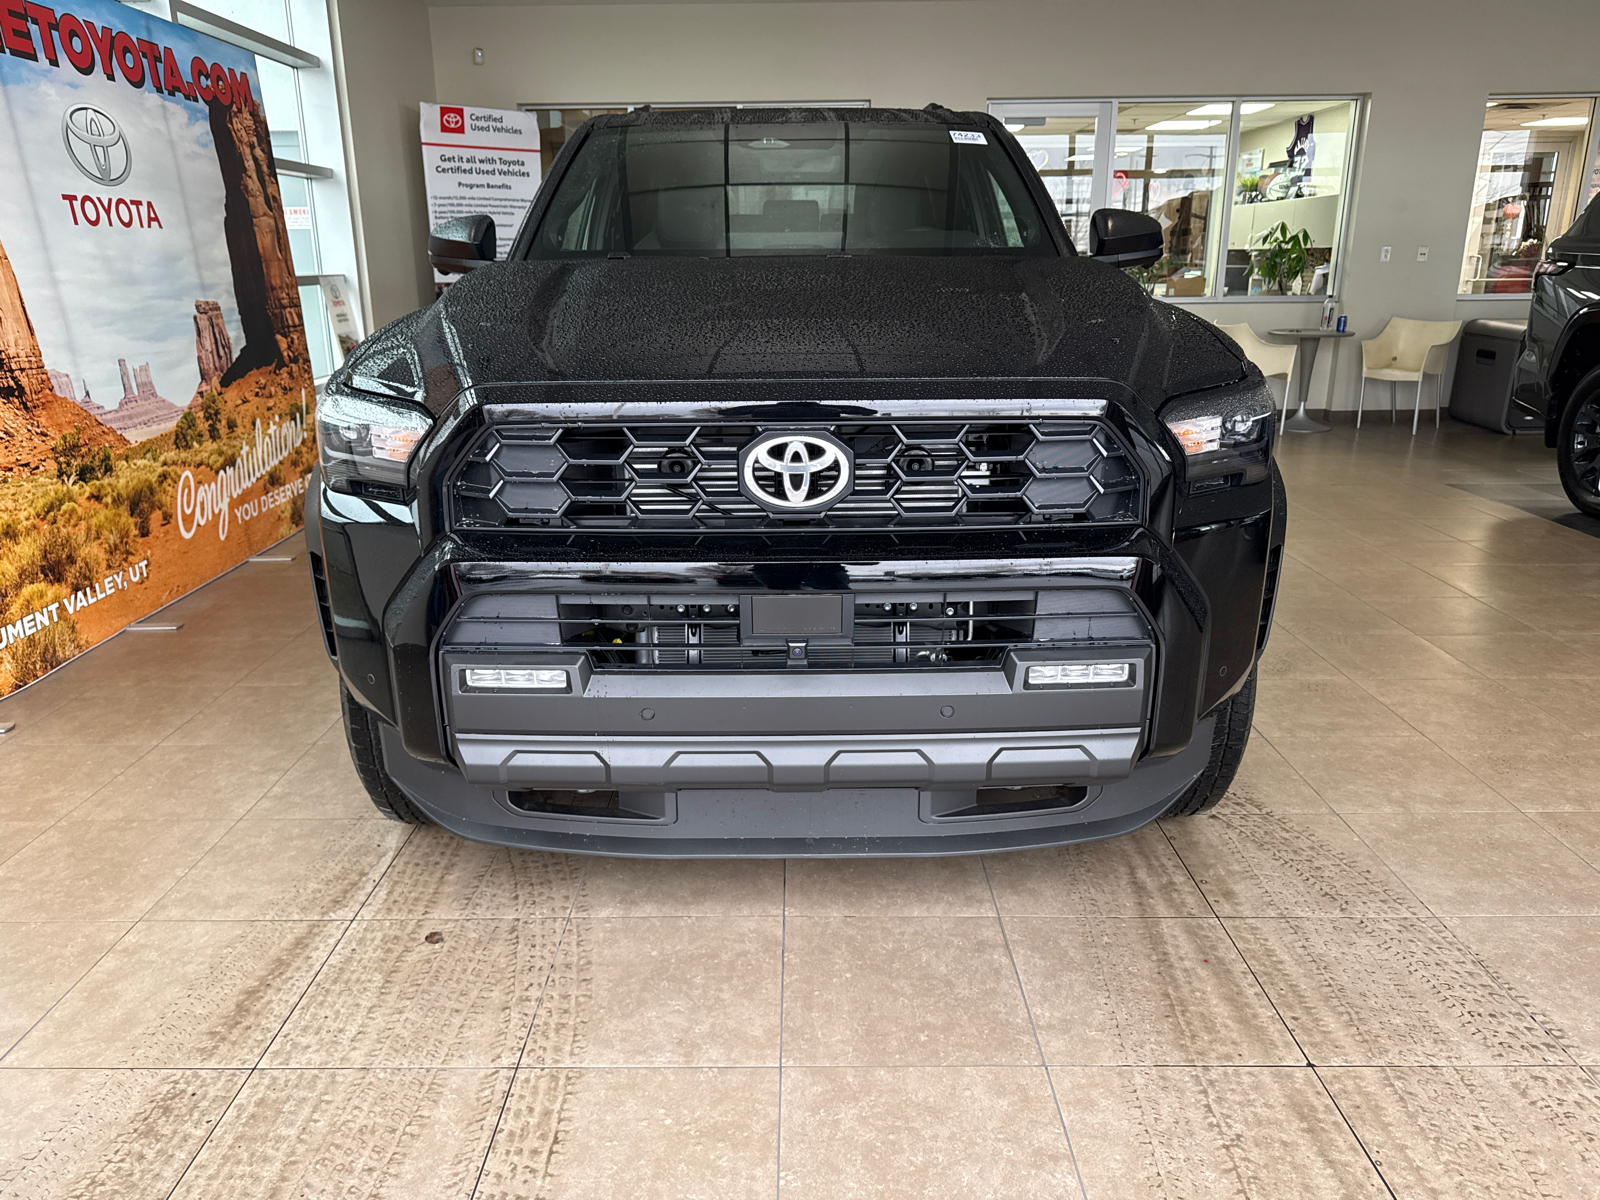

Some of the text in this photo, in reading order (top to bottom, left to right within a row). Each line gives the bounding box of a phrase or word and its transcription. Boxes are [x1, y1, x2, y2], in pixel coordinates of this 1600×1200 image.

[0, 0, 255, 112] ETOYOTA.COM
[469, 112, 504, 123] Certified
[470, 123, 523, 135] Used Vehicles
[435, 165, 530, 178] Certified Used Vehicles
[440, 153, 526, 168] Get it all with Toyota
[457, 181, 512, 190] Program Benefits
[61, 193, 164, 230] TOYOTA
[177, 387, 308, 541] Congratulations!
[234, 499, 259, 524] YOU
[260, 478, 304, 513] DESERVE
[62, 571, 128, 615] VALLEY,
[128, 559, 148, 583] UT
